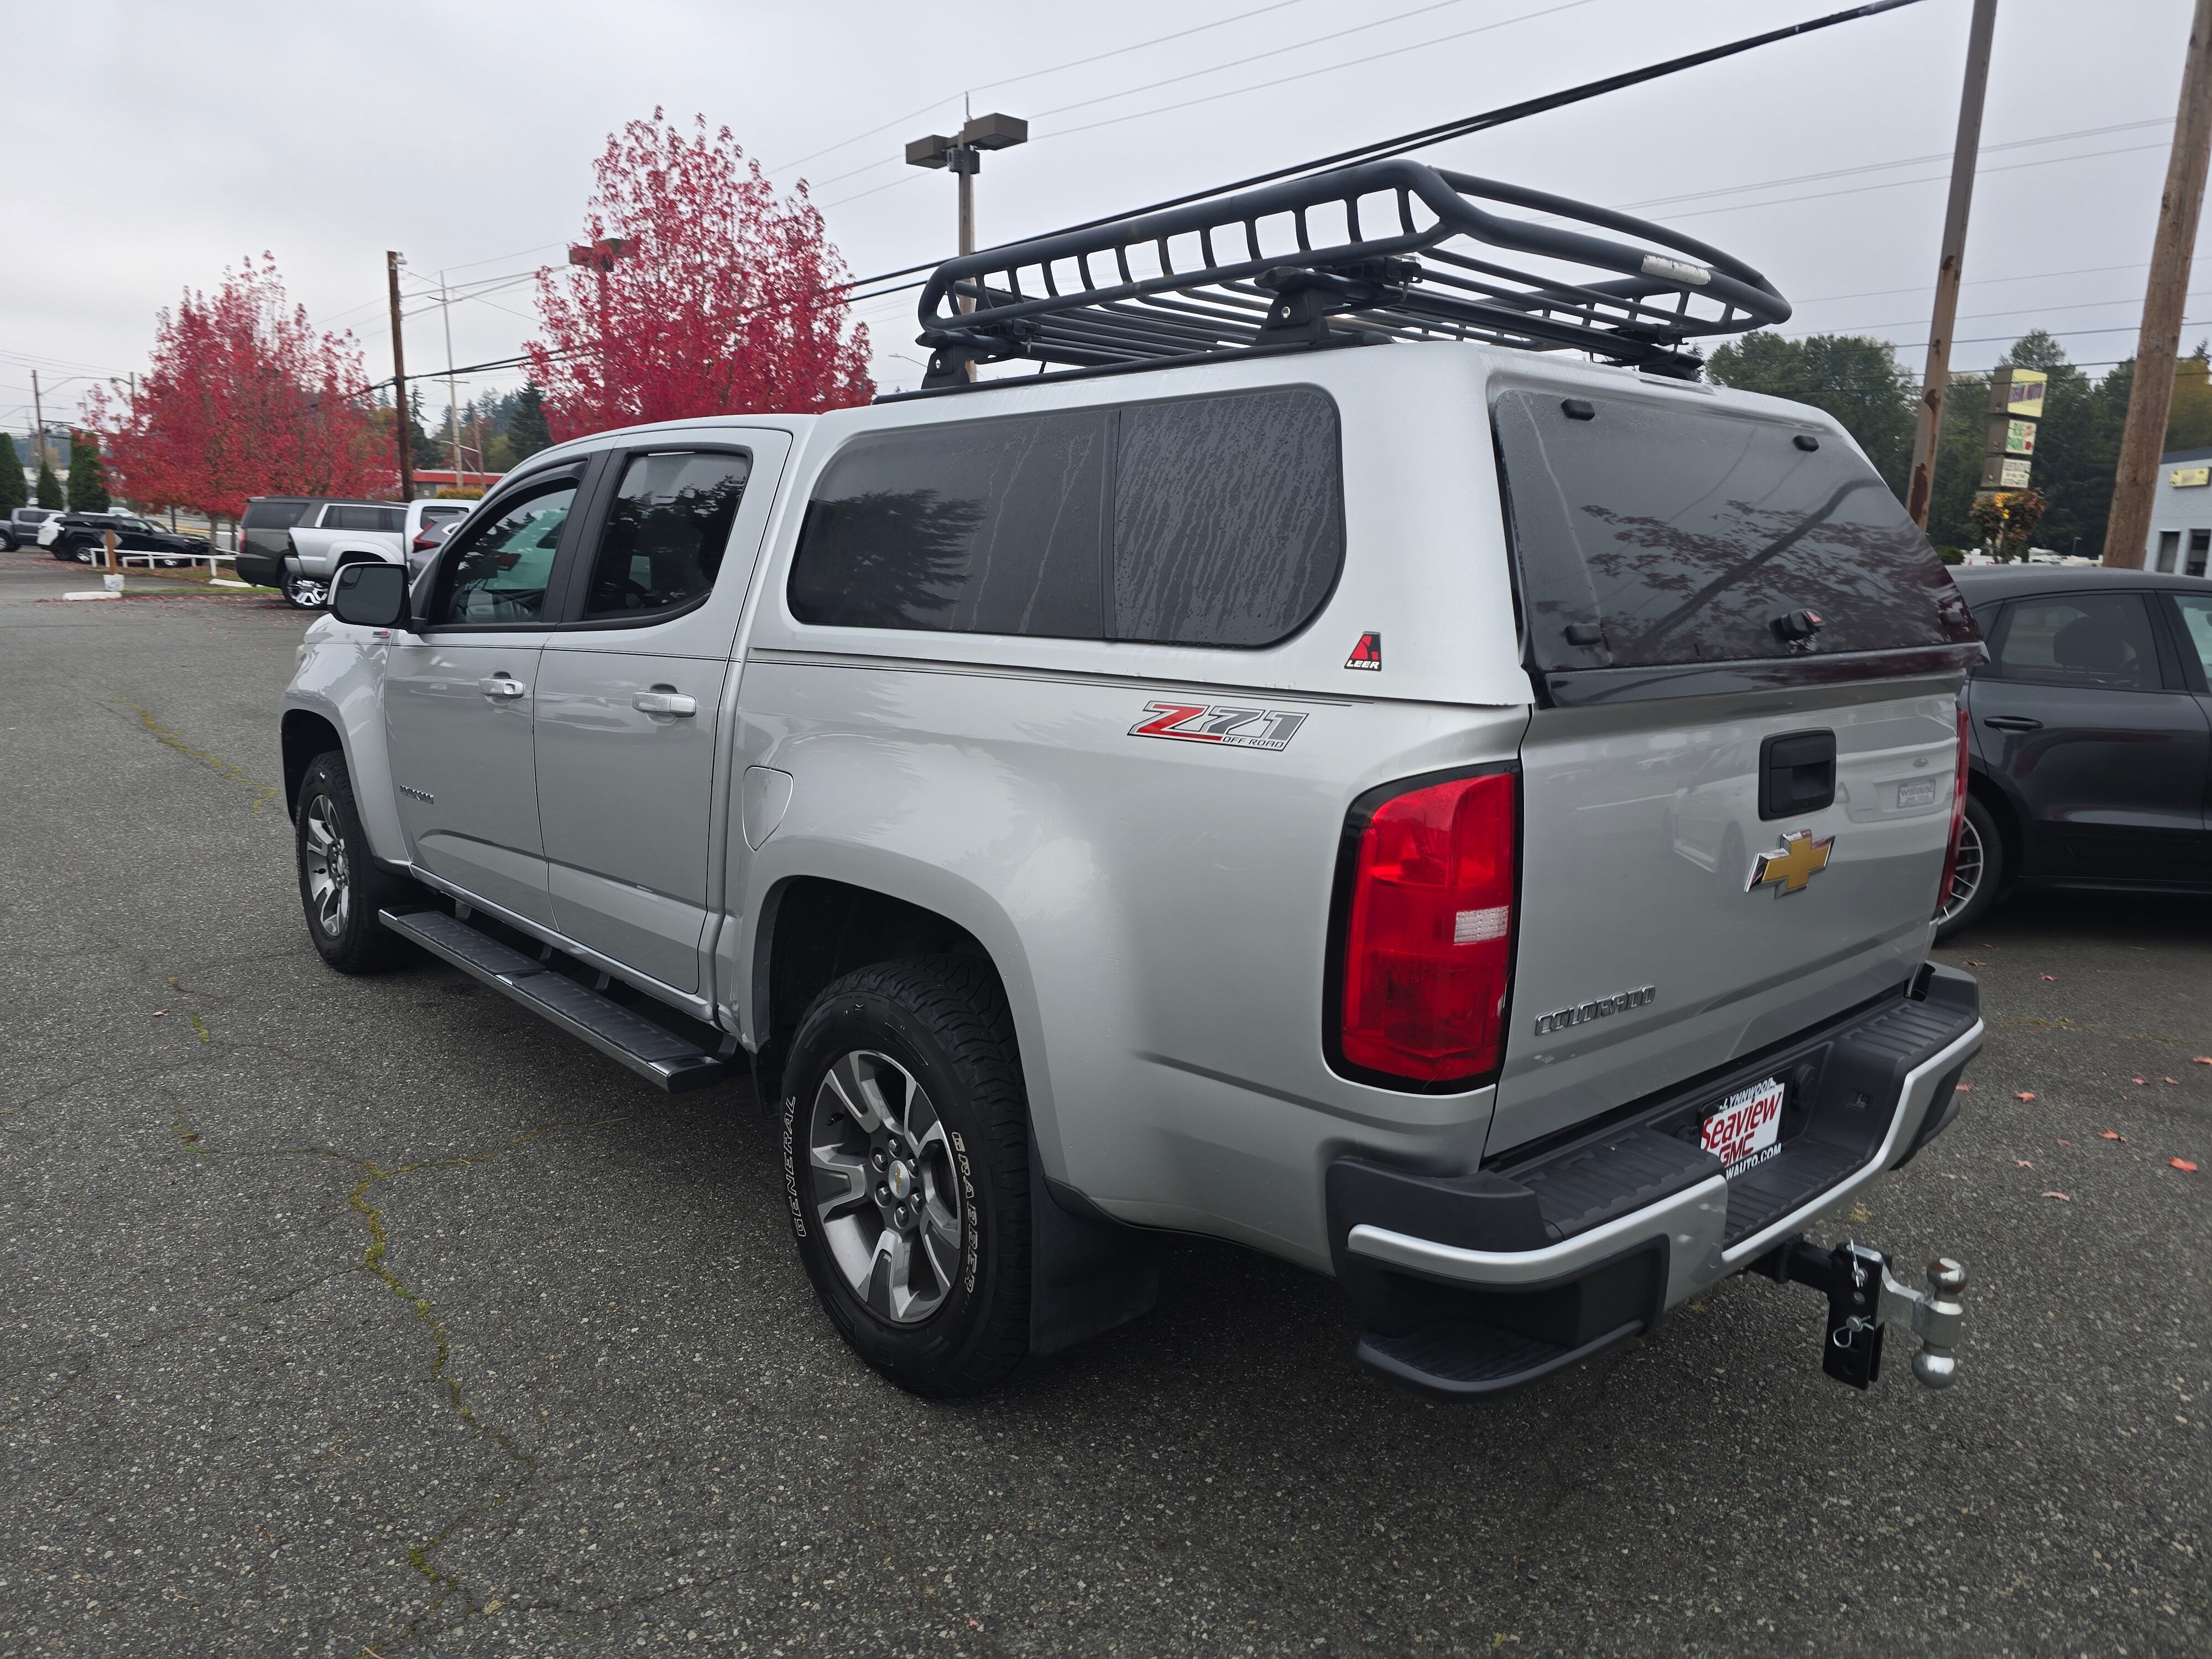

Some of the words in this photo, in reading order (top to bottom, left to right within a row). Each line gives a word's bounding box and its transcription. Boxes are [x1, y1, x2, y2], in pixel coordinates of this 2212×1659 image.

[1346, 660, 1380, 670] LEER
[1127, 700, 1309, 742] Z71
[1222, 736, 1244, 745] OFF
[1249, 738, 1284, 749] ROAD
[1535, 984, 1656, 1036] COLORADO
[1722, 1077, 1774, 1110] LYNNWOOD
[1702, 1091, 1782, 1151] Seaview
[783, 1096, 807, 1237] GENERAL
[1719, 1131, 1755, 1166] GMC
[951, 1131, 978, 1293] GRABBER
